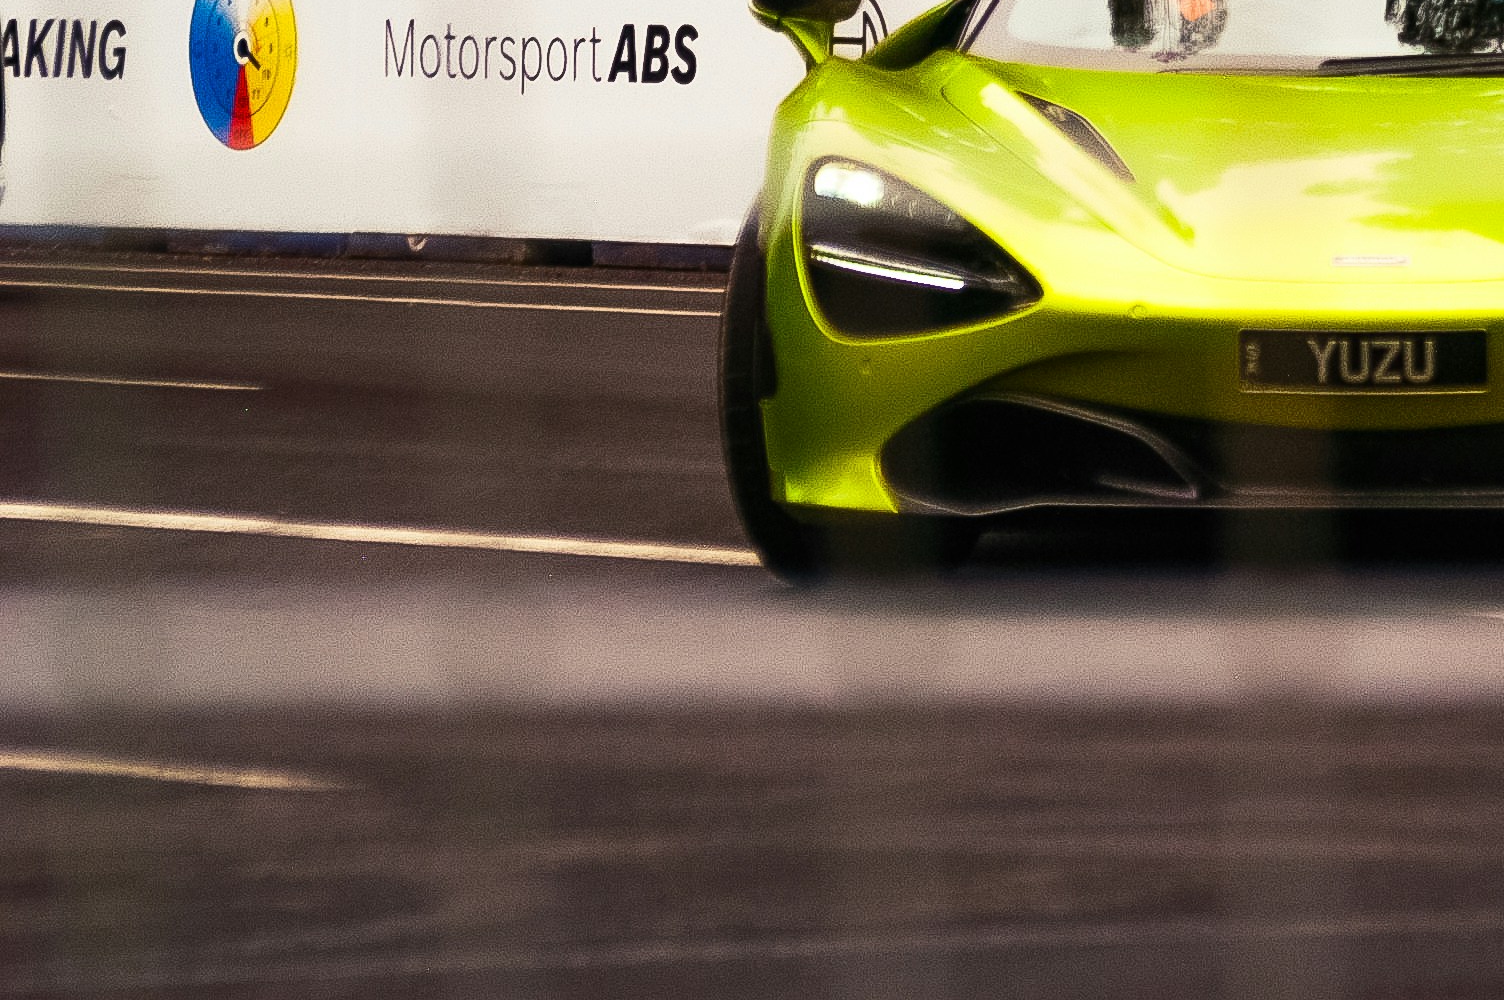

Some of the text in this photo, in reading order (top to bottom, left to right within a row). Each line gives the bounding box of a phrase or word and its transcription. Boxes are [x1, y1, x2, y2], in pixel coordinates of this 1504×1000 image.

[2, 18, 127, 80] AKING
[385, 18, 699, 95] Motorsport ABS
[1306, 340, 1436, 384] YUZU
